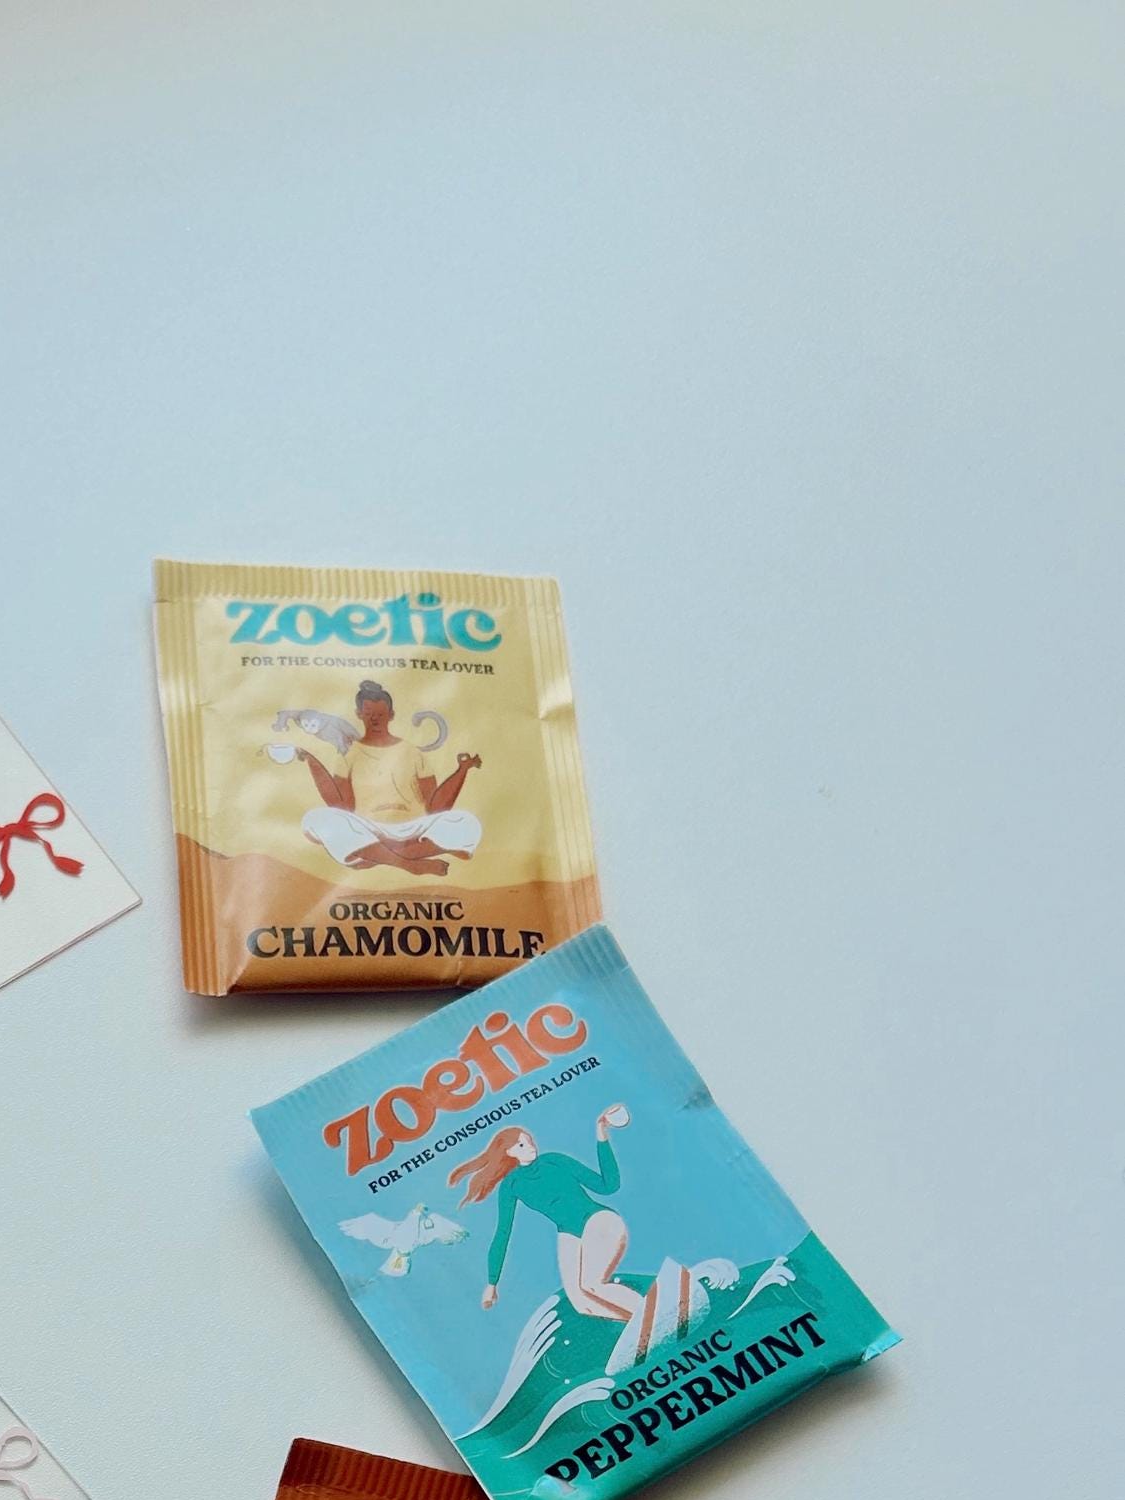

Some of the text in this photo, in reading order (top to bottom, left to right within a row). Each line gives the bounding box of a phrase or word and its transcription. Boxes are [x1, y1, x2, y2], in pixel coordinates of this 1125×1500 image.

[226, 592, 503, 653] zoetic
[241, 656, 495, 675] FOR THE CONSCIOUS TEA LOVER
[329, 901, 465, 921] ORGANIC
[323, 1004, 588, 1177] zoetic
[367, 1056, 601, 1194] FOR THE CONSCIOUS TEA LOVER
[611, 1329, 733, 1411] ORGANIC
